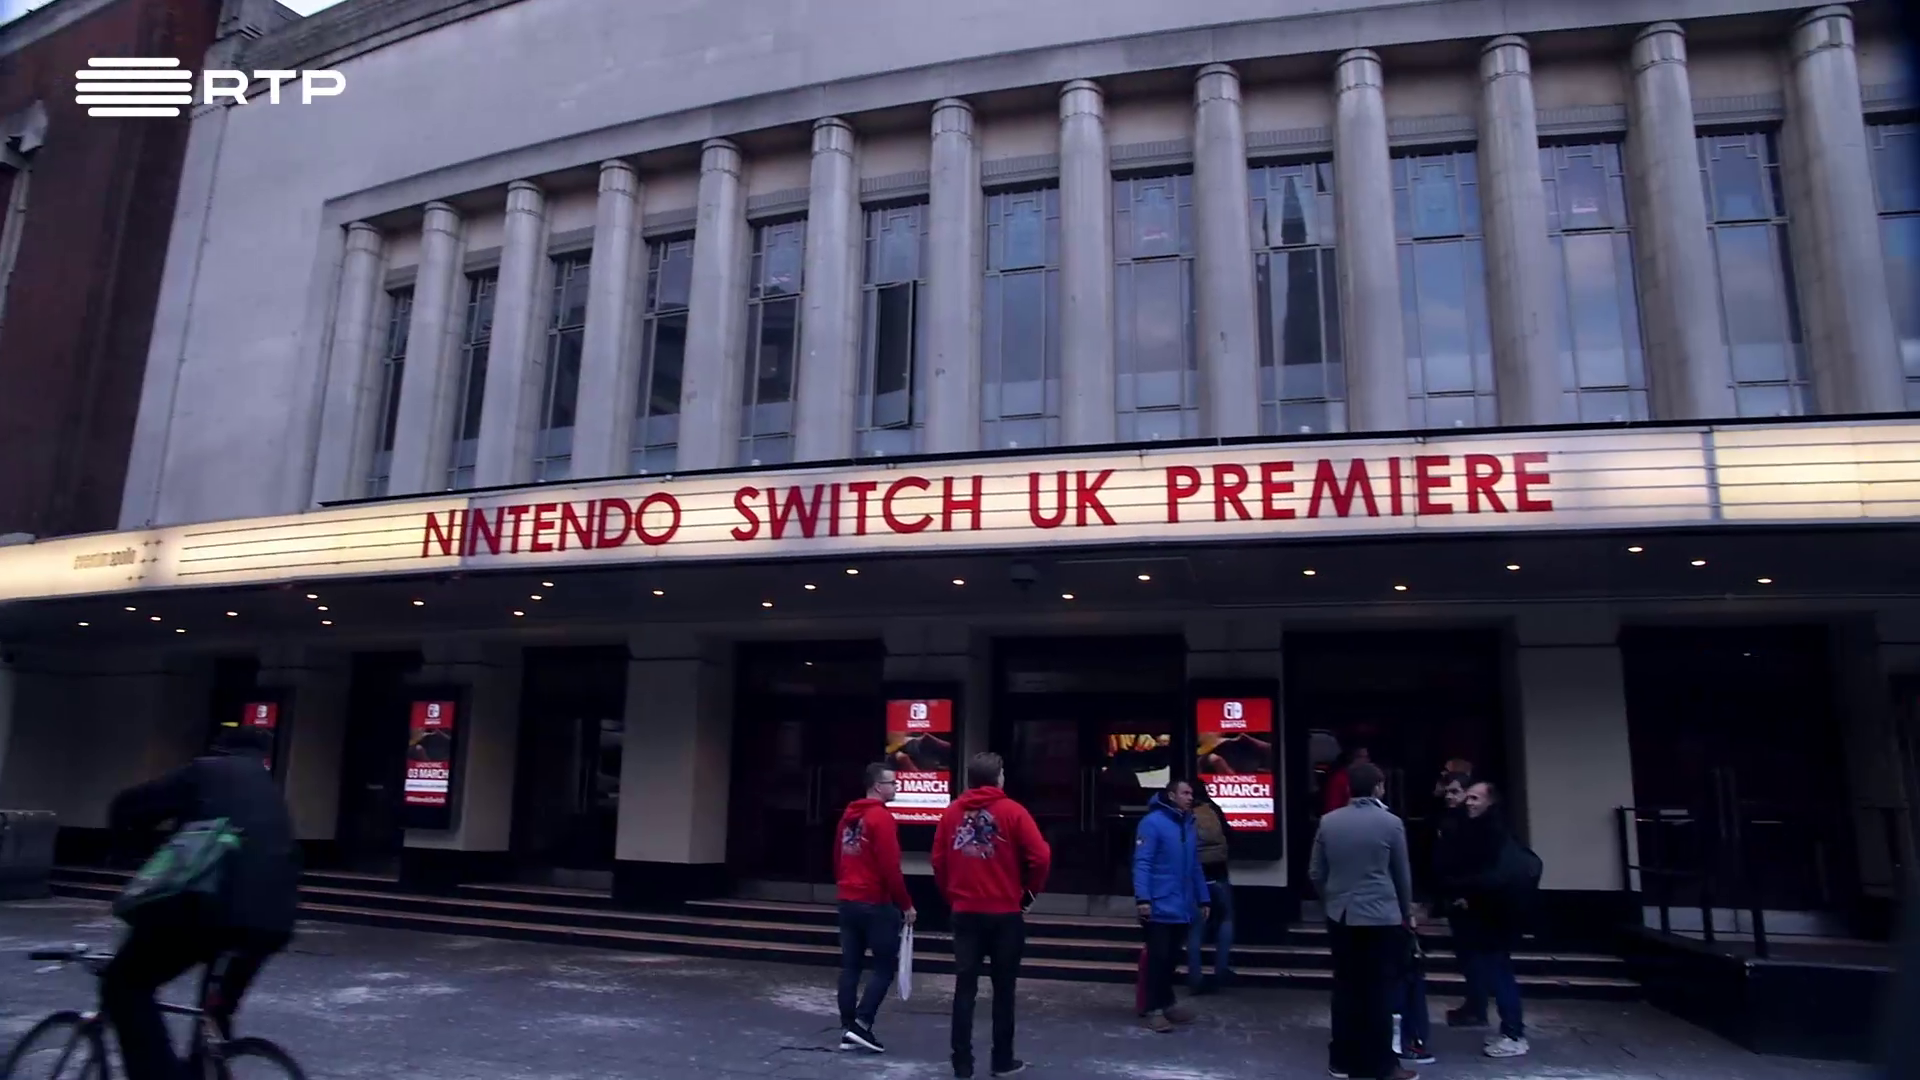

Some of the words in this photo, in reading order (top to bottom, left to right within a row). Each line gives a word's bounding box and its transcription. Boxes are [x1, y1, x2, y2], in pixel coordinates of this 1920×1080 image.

[422, 491, 682, 558] NINTENDO
[730, 475, 983, 542] SWITCH
[1029, 469, 1118, 530] UK
[1166, 451, 1555, 525] PREMIERE
[408, 769, 418, 778] 03
[419, 769, 449, 779] MARCH
[1212, 775, 1257, 783] LAUNCHING
[904, 780, 948, 792] MARCH
[1205, 784, 1217, 796] 3
[1219, 784, 1270, 796] MARCH
